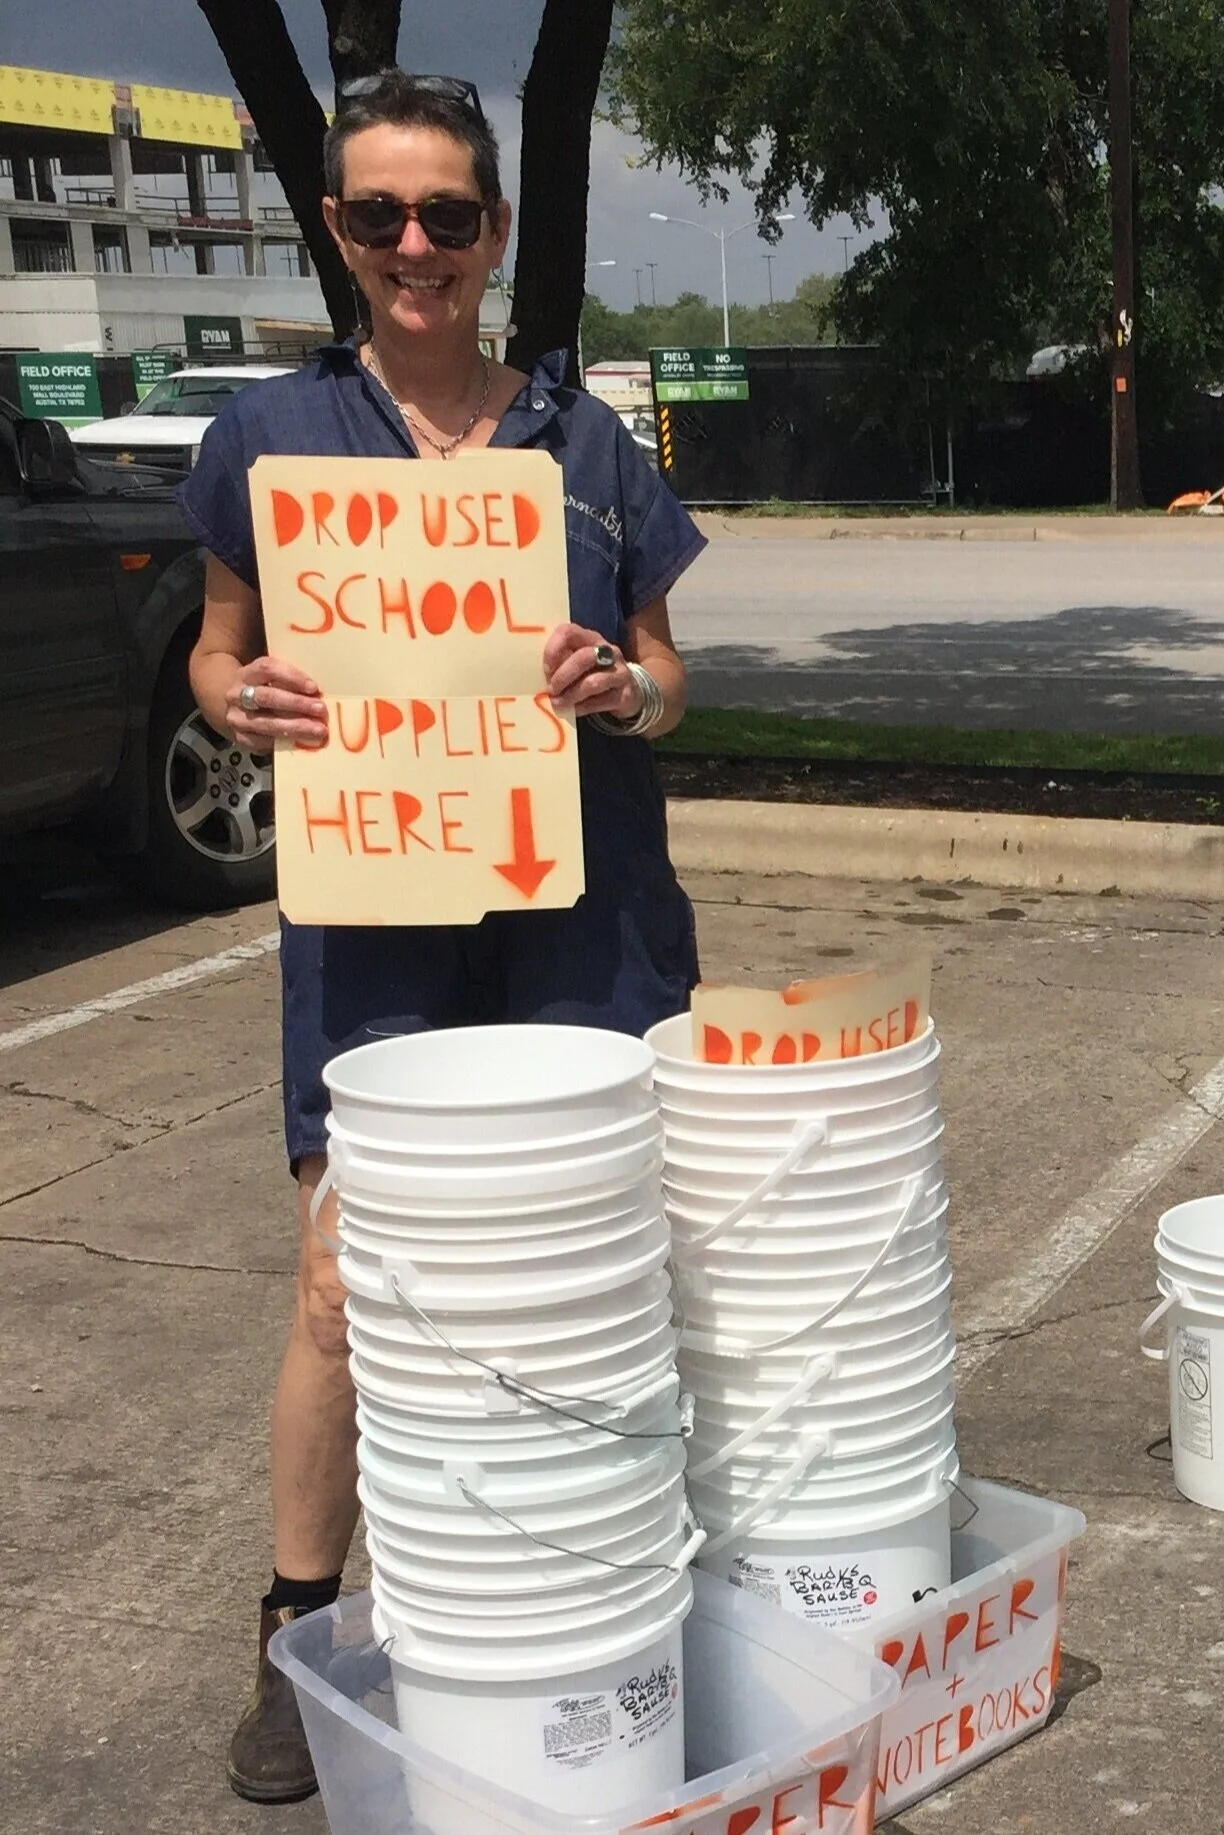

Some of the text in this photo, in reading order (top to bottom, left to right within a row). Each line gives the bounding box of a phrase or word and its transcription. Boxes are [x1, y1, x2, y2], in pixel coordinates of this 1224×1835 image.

[201, 329, 231, 344] RYAN
[660, 363, 695, 372] OFFICE
[662, 352, 691, 362] FIELD
[715, 354, 731, 364] NO
[20, 366, 92, 377] FIELD OFFICE
[270, 488, 399, 550] DROP
[420, 491, 541, 550] USED
[289, 571, 546, 640] SCHOOL
[301, 787, 475, 856] HERE
[703, 999, 919, 1066] DROP USED
[877, 1665, 1049, 1797] NOTEBOOKS
[689, 1766, 856, 1835] PER
